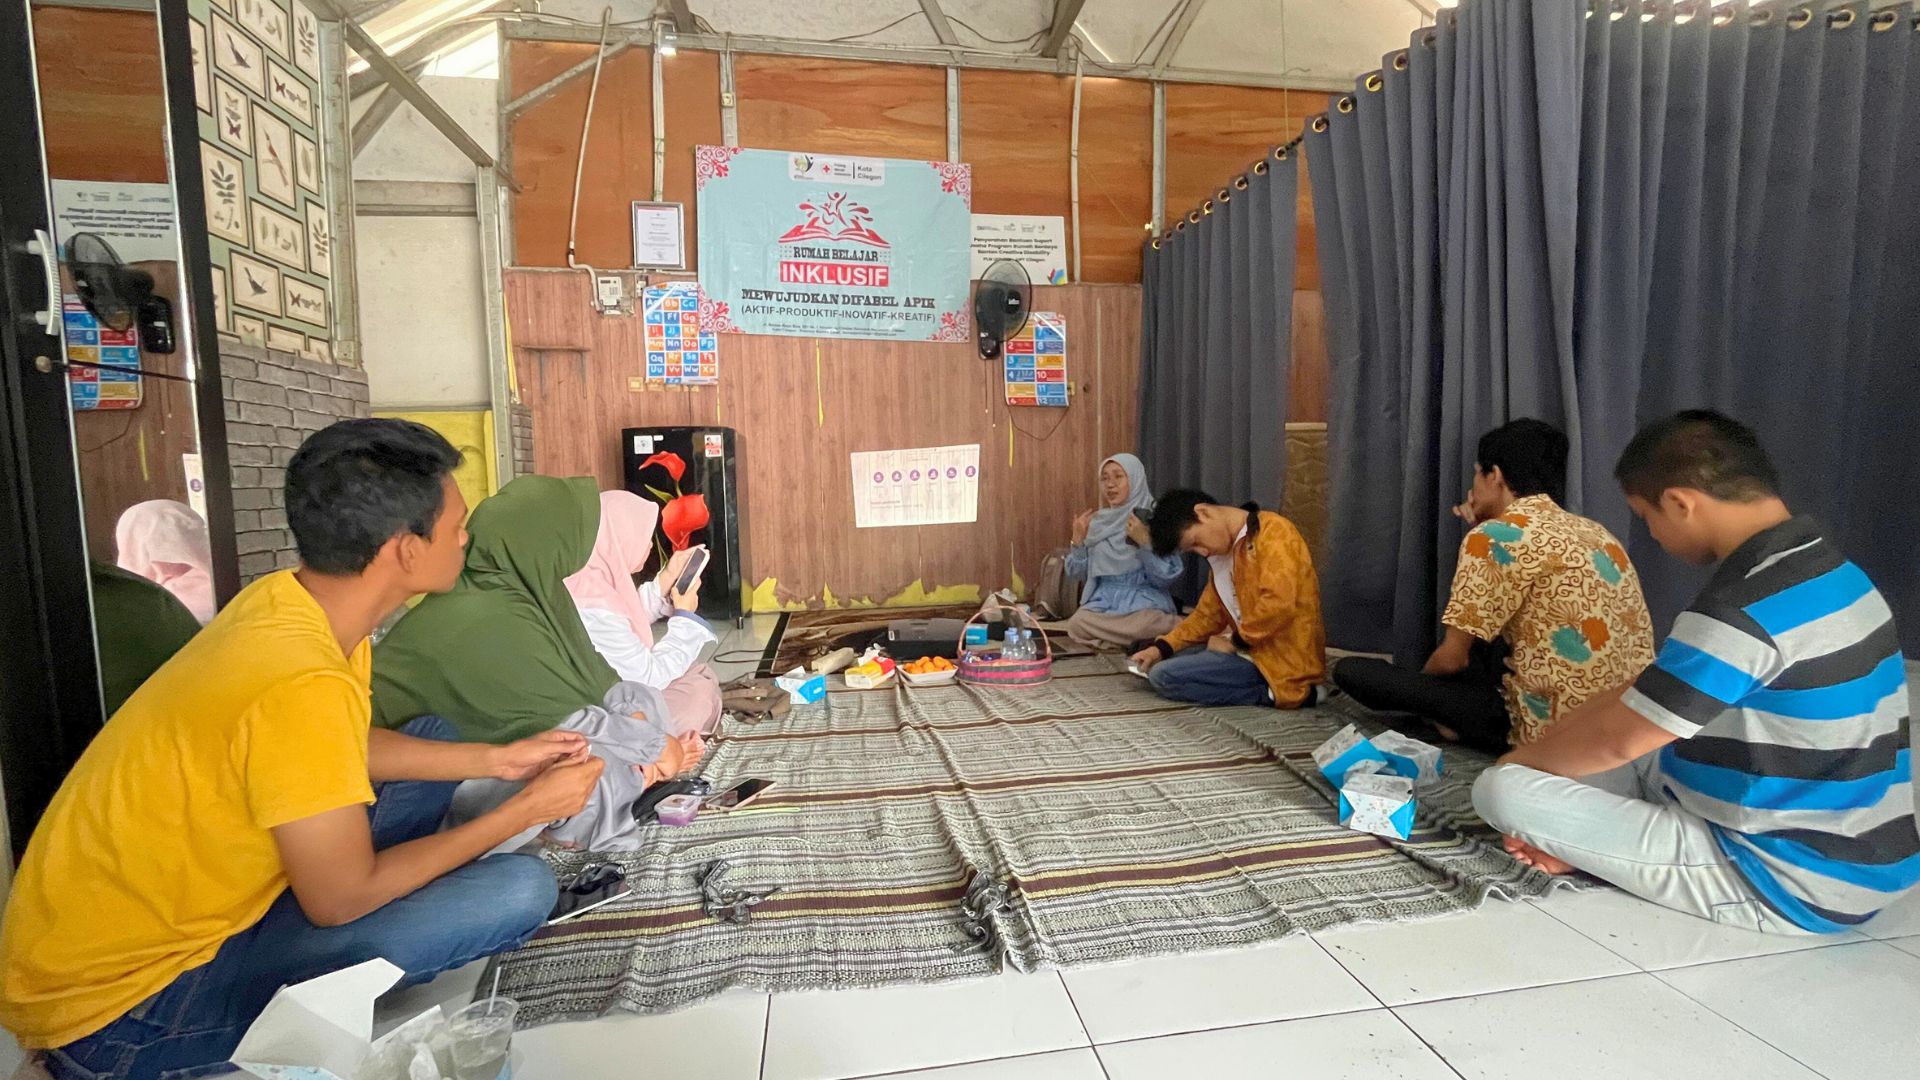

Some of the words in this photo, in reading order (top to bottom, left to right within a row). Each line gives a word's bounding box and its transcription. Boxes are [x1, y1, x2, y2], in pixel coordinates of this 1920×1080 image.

[857, 172, 882, 181] Cilegon
[793, 246, 830, 259] RUMAH
[832, 248, 879, 262] BELAJAR
[782, 263, 887, 286] INKLUSIF
[682, 299, 695, 307] Cc
[741, 288, 840, 305] MEWUJUDKAN
[841, 294, 899, 307] DIFABEL
[903, 296, 936, 309] APIK
[667, 313, 677, 321] Ff
[682, 313, 696, 323] Gg
[741, 304, 936, 323] (AKTIF-PRODUKTIF-INOVATIF-KREATIF)
[700, 339, 713, 348] Pp
[650, 354, 663, 363] Qq
[1037, 371, 1047, 379] 10
